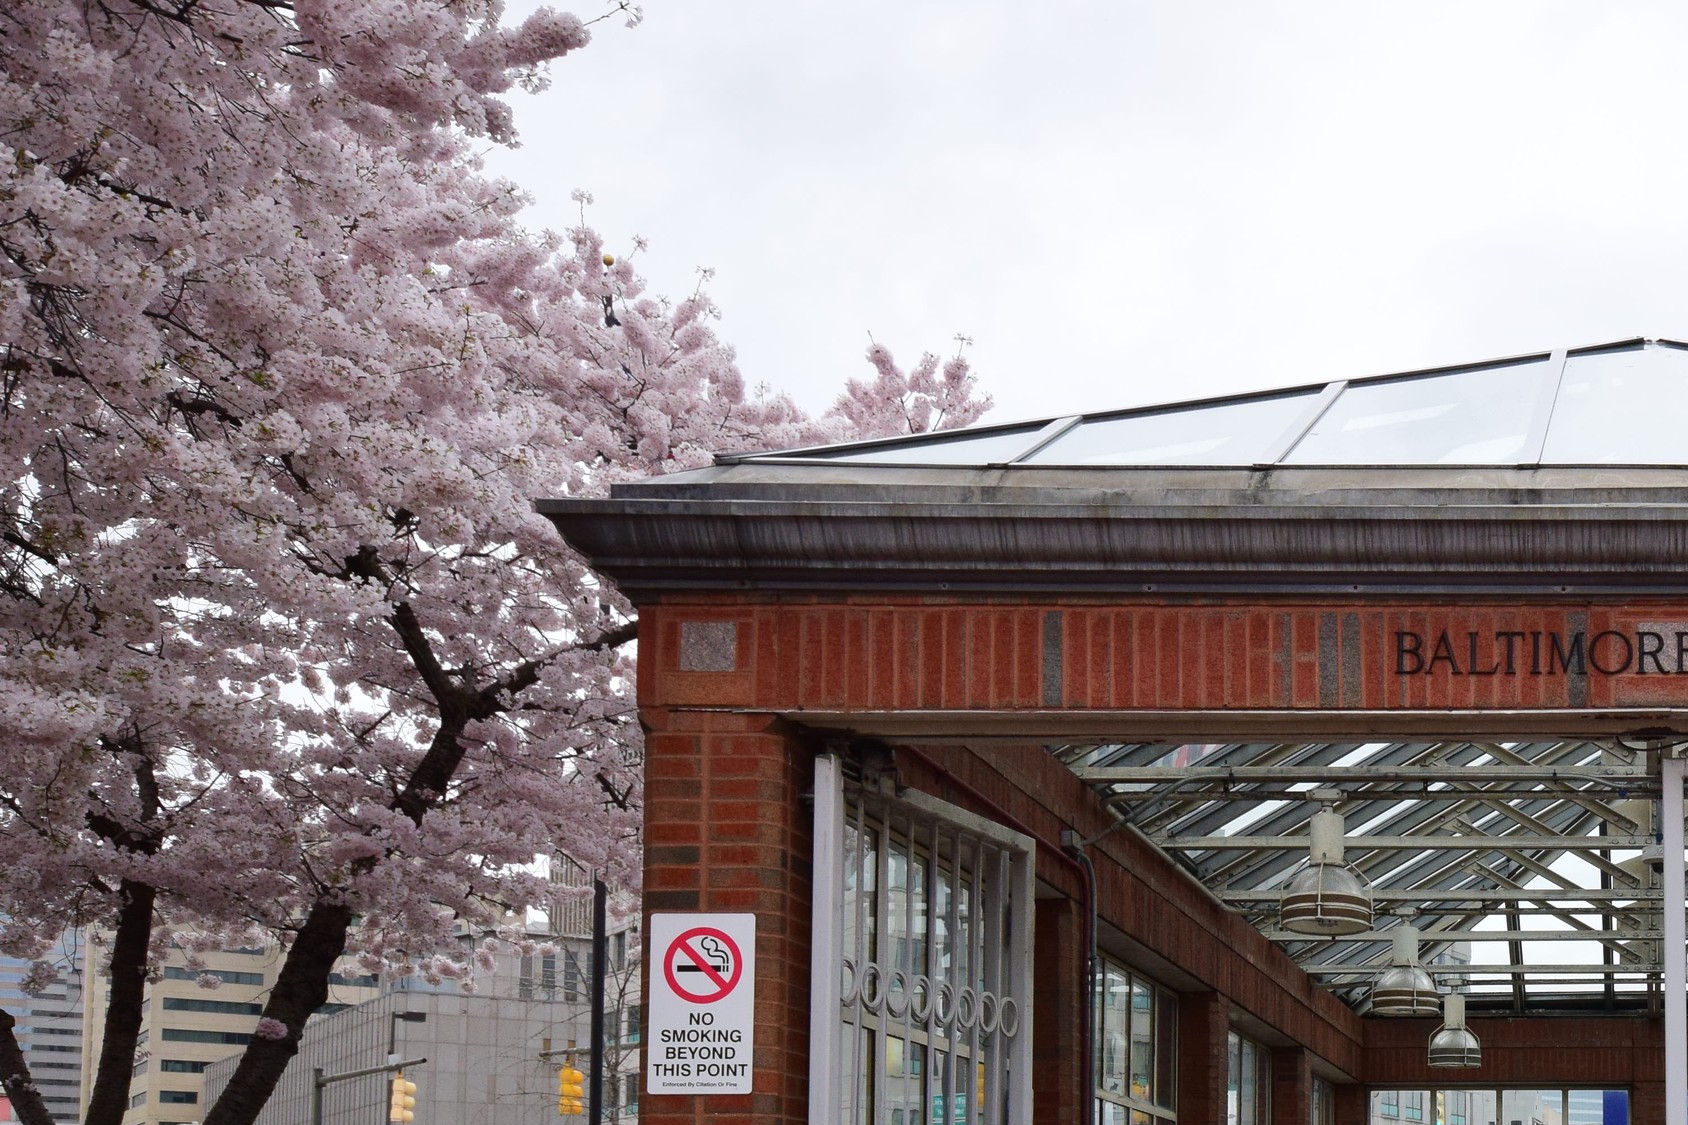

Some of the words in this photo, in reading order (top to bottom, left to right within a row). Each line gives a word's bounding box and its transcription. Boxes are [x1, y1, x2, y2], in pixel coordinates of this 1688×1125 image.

[689, 1012, 714, 1026] NO
[660, 1029, 742, 1043] SMOKING
[665, 1046, 736, 1060] BEYOND
[652, 1063, 692, 1077] THIS
[696, 1063, 749, 1077] POINT
